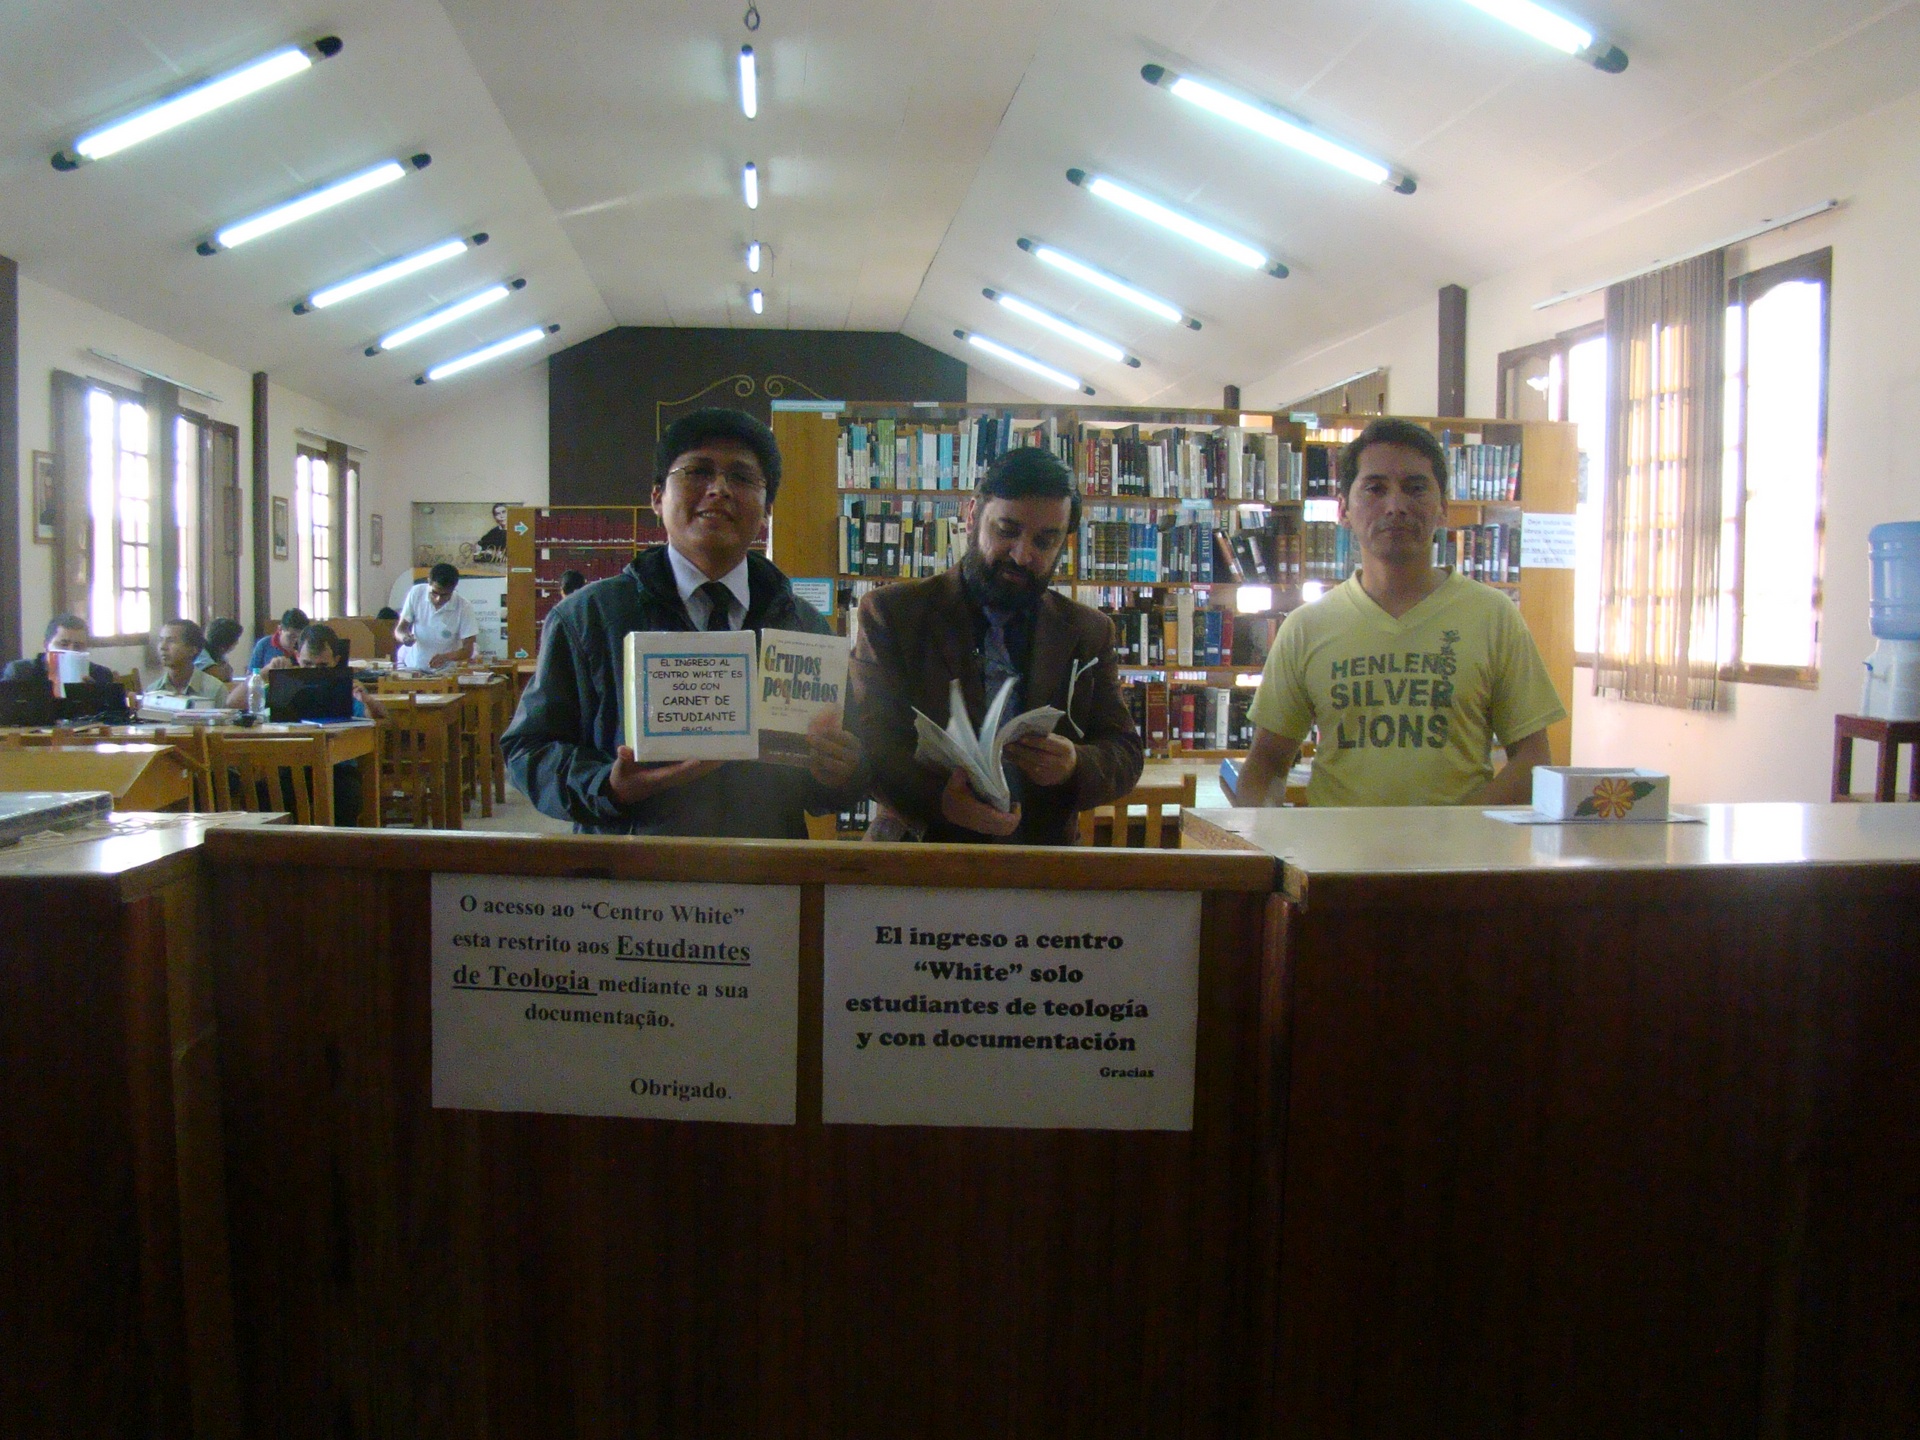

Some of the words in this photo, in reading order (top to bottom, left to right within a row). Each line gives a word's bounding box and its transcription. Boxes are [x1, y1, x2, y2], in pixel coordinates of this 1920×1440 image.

[660, 658, 671, 667] EL
[674, 658, 716, 667] INGRESO
[719, 658, 730, 667] AL
[731, 670, 743, 679] ES
[764, 644, 822, 680] Grupos
[673, 680, 697, 691] SÓLO
[700, 682, 721, 691] CON
[762, 676, 839, 704] pequeños
[1331, 679, 1455, 710] SILVER
[662, 695, 710, 706] CARNET
[715, 695, 731, 706] DE
[657, 711, 736, 723] ESTUDIANTE
[1337, 714, 1449, 749] LIONS
[459, 894, 477, 912] O
[484, 900, 545, 916] acesso
[552, 904, 574, 918] ao
[452, 933, 491, 948] esta
[498, 933, 571, 953] restrito
[577, 940, 609, 955] aos
[617, 934, 751, 962] Estudantes
[876, 926, 902, 946] El
[910, 927, 1008, 951] ingreso
[1014, 933, 1029, 949] a
[1036, 932, 1124, 950] centro
[453, 964, 481, 985] de
[488, 965, 590, 993] Teologia
[599, 976, 691, 996] mediante
[697, 983, 708, 997] a
[715, 985, 749, 999] sua
[1030, 964, 1084, 983] solo
[524, 1003, 675, 1031] documentação.
[845, 995, 999, 1015] estudiantes
[1005, 996, 1036, 1016] de
[1044, 998, 1149, 1022] teología
[855, 1032, 873, 1050] y
[879, 1030, 926, 1048] con
[933, 1029, 1136, 1052] documentación
[1099, 1066, 1155, 1079] Gracias
[630, 1077, 732, 1102] Obrigado.
